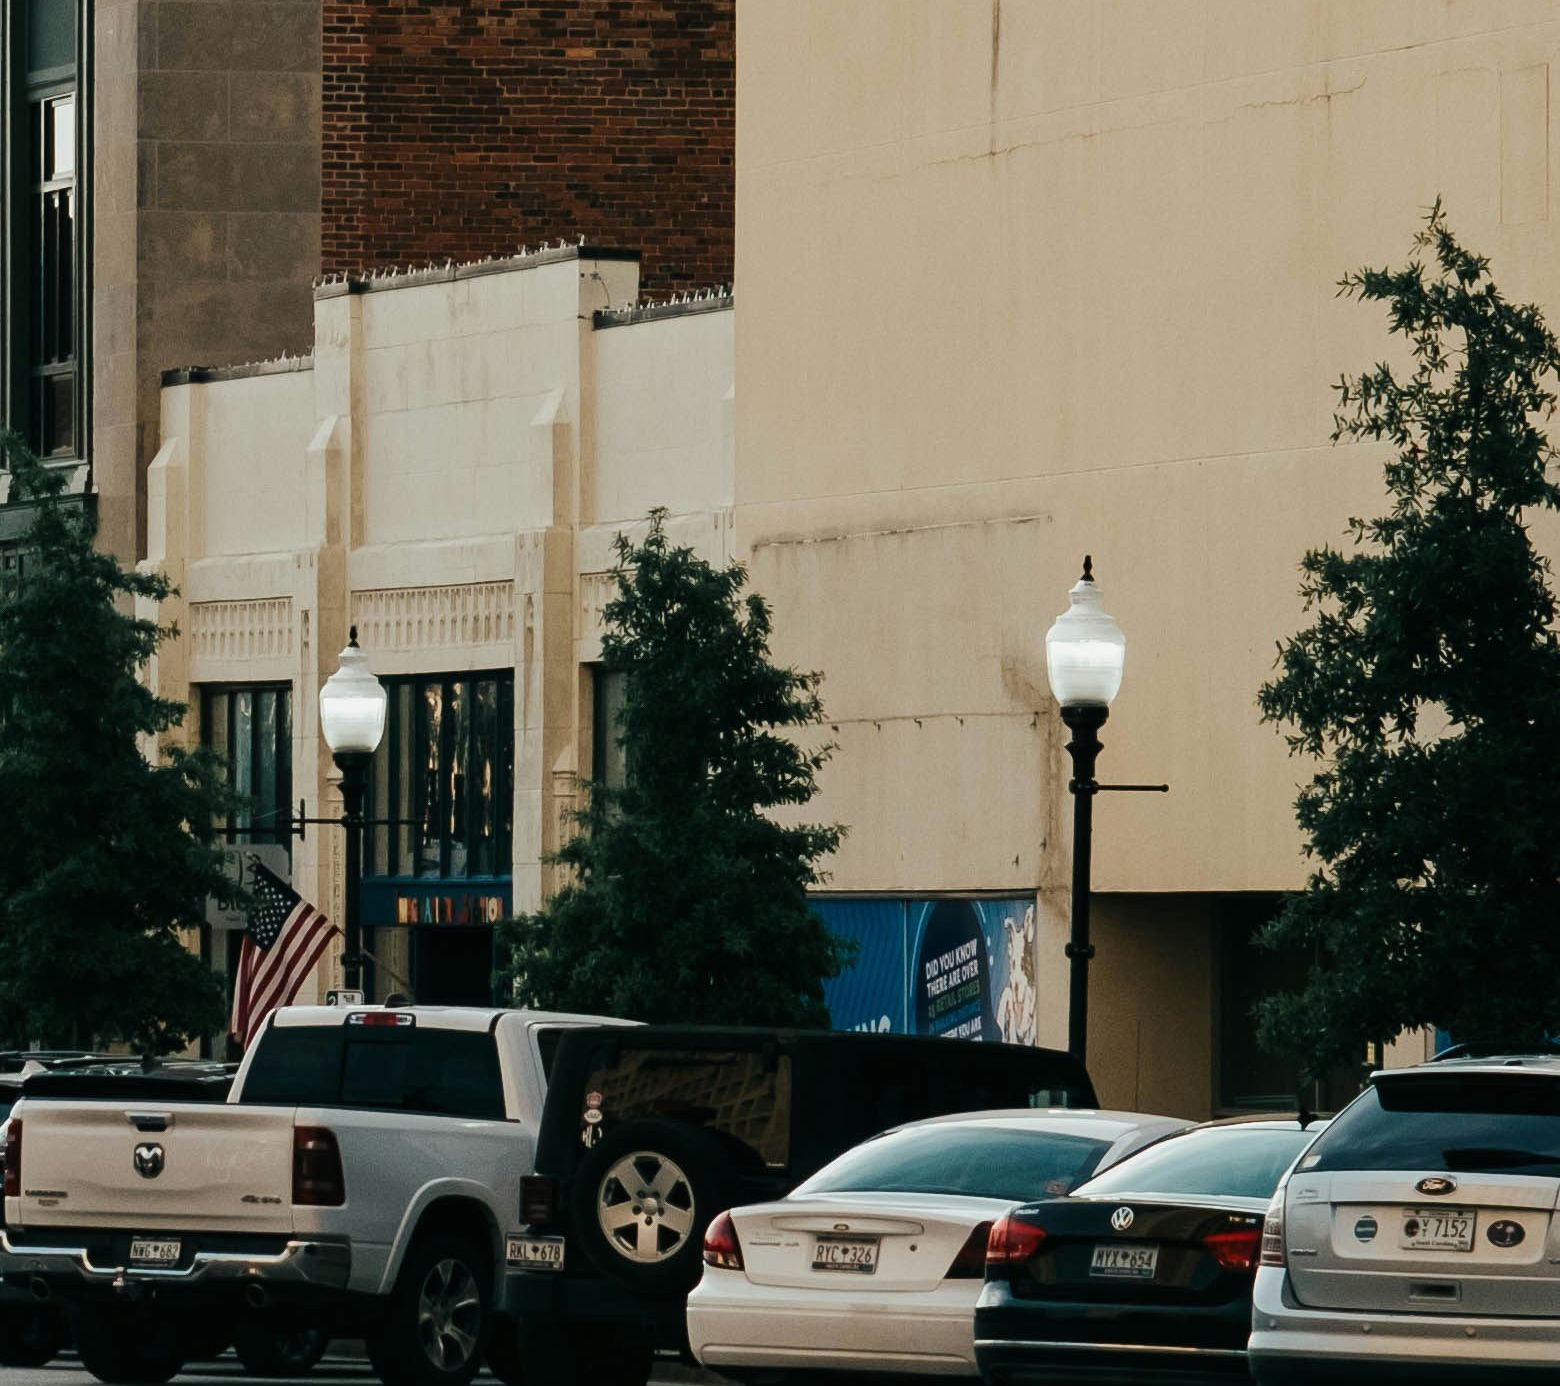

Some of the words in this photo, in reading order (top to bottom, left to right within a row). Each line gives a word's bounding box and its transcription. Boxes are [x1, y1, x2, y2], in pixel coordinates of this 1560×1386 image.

[925, 958, 939, 980] DID
[939, 950, 955, 973] YOU
[955, 938, 978, 966] KNOW
[927, 975, 948, 998] THERE
[949, 968, 961, 989] ARE
[961, 959, 979, 982] OVER
[959, 1020, 971, 1039] YOU
[971, 1015, 982, 1033] ARE
[1434, 1219, 1468, 1238] 7152
[540, 1244, 561, 1262] 678
[816, 1244, 840, 1263] RYC
[849, 1246, 873, 1264] 326
